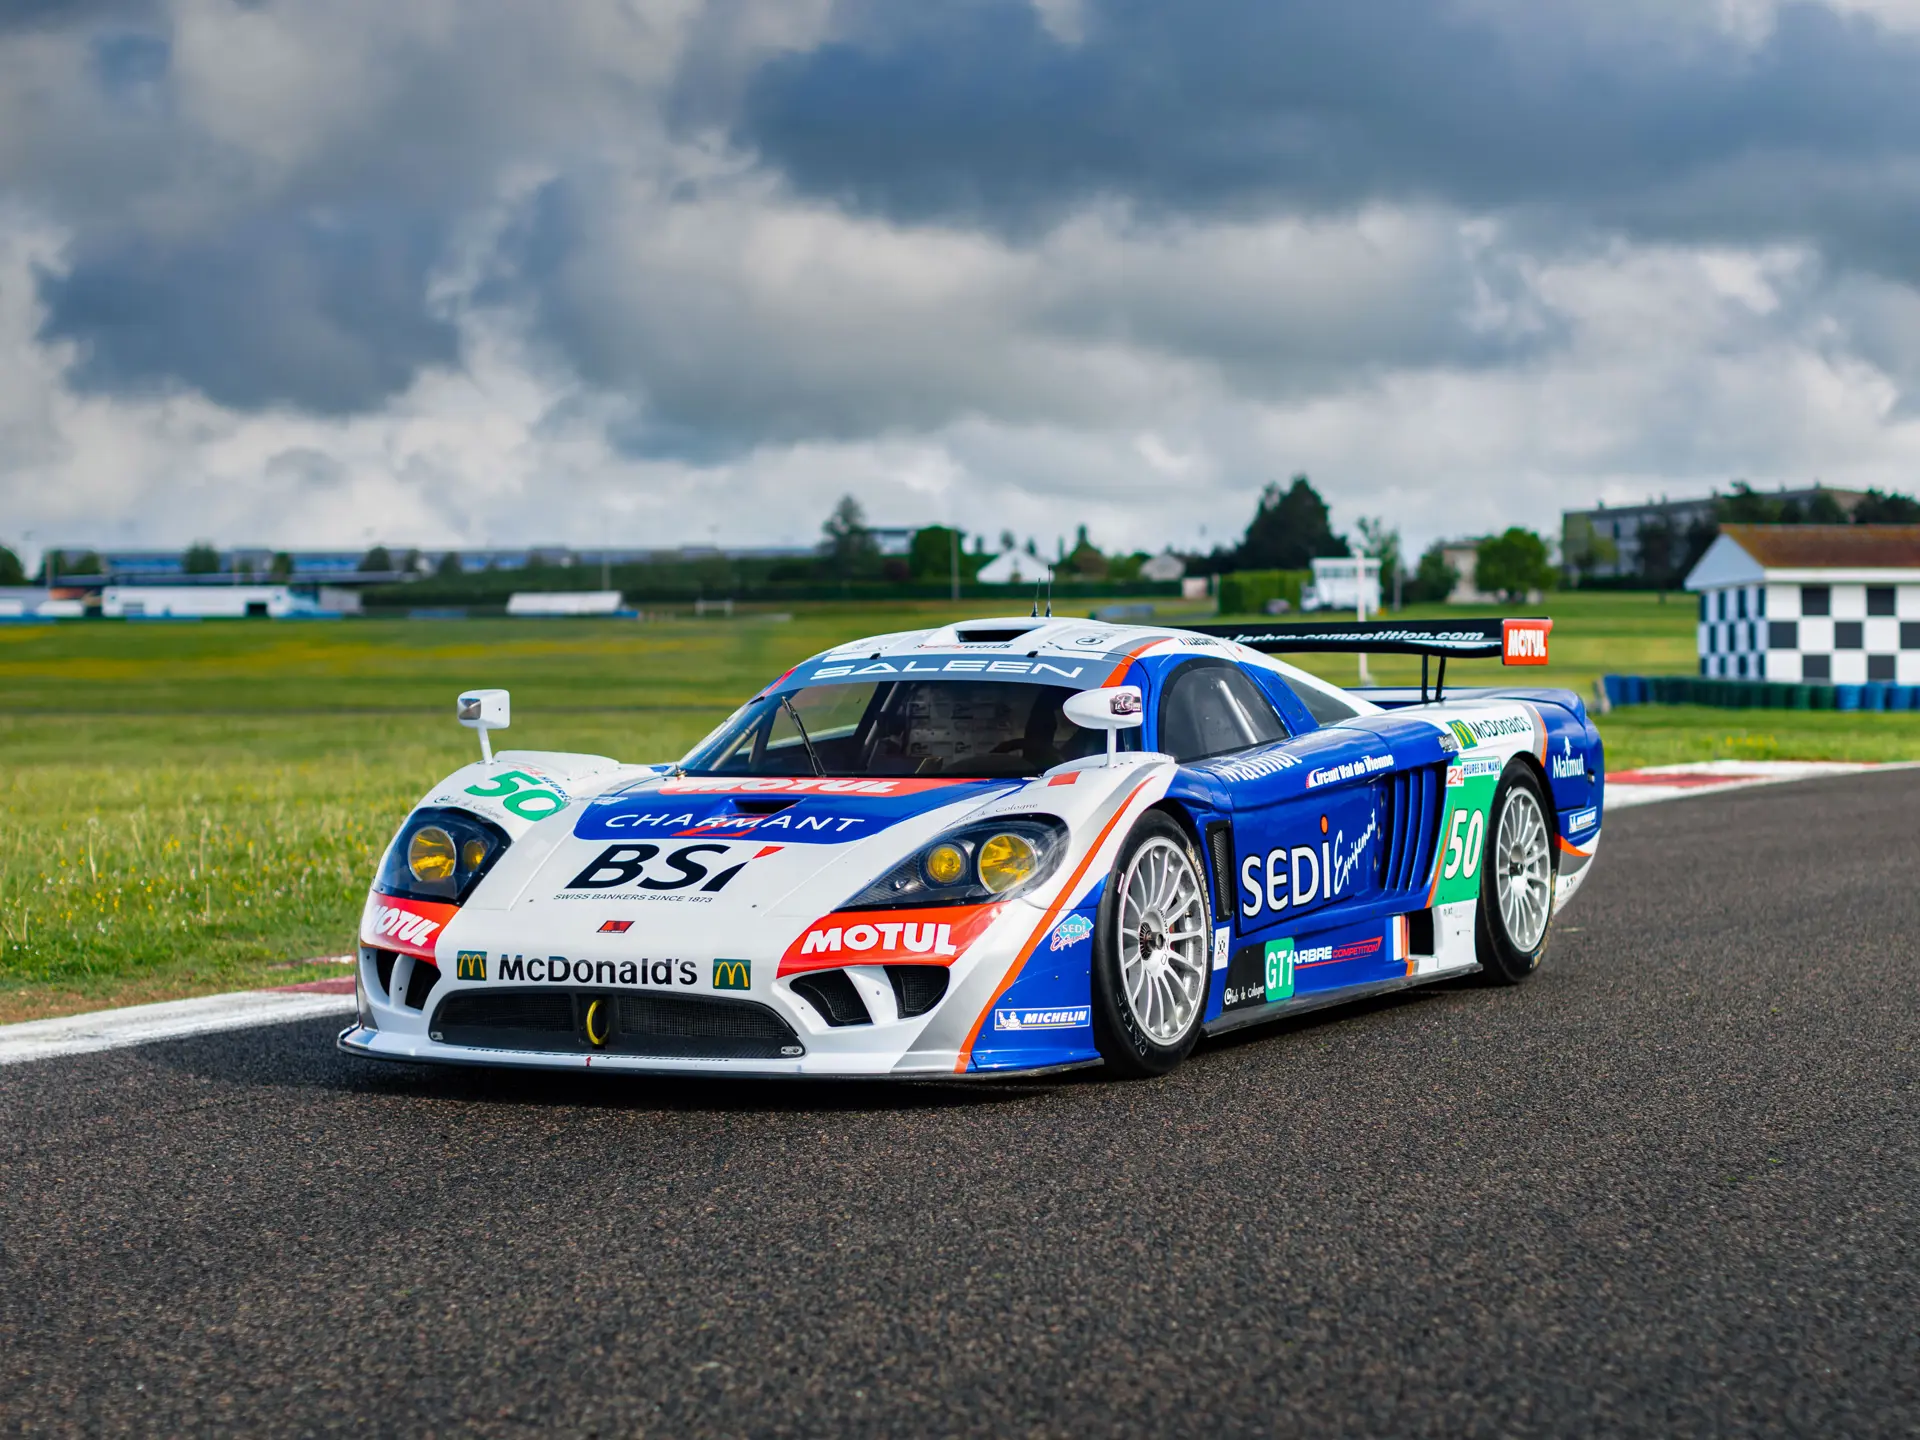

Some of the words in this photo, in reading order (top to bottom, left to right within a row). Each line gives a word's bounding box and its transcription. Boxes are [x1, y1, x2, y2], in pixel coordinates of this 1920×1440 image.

[1508, 629, 1546, 657] MOTUL
[810, 660, 1084, 680] SALEEN
[1469, 715, 1532, 739] McDonald's
[1306, 767, 1340, 788] Circuit
[1339, 763, 1354, 779] Val
[1354, 761, 1365, 775] de
[1361, 754, 1394, 772] Vienne
[1448, 768, 1464, 785] 24
[1464, 763, 1480, 775] HEURES
[1553, 753, 1585, 779] Matmut
[464, 770, 569, 821] 50
[676, 779, 901, 793] MOTUL
[605, 813, 866, 832] CHARMANT
[1444, 807, 1484, 880] 50
[592, 893, 647, 901] BANKERS
[648, 894, 685, 902] SINCE
[801, 922, 957, 955] MOTUL
[1293, 946, 1333, 964] ARBRE
[1333, 944, 1378, 958] COMPETITION
[498, 954, 698, 985] McDonald's
[1265, 949, 1293, 990] GT1
[1023, 1011, 1086, 1024] MICHELIN
